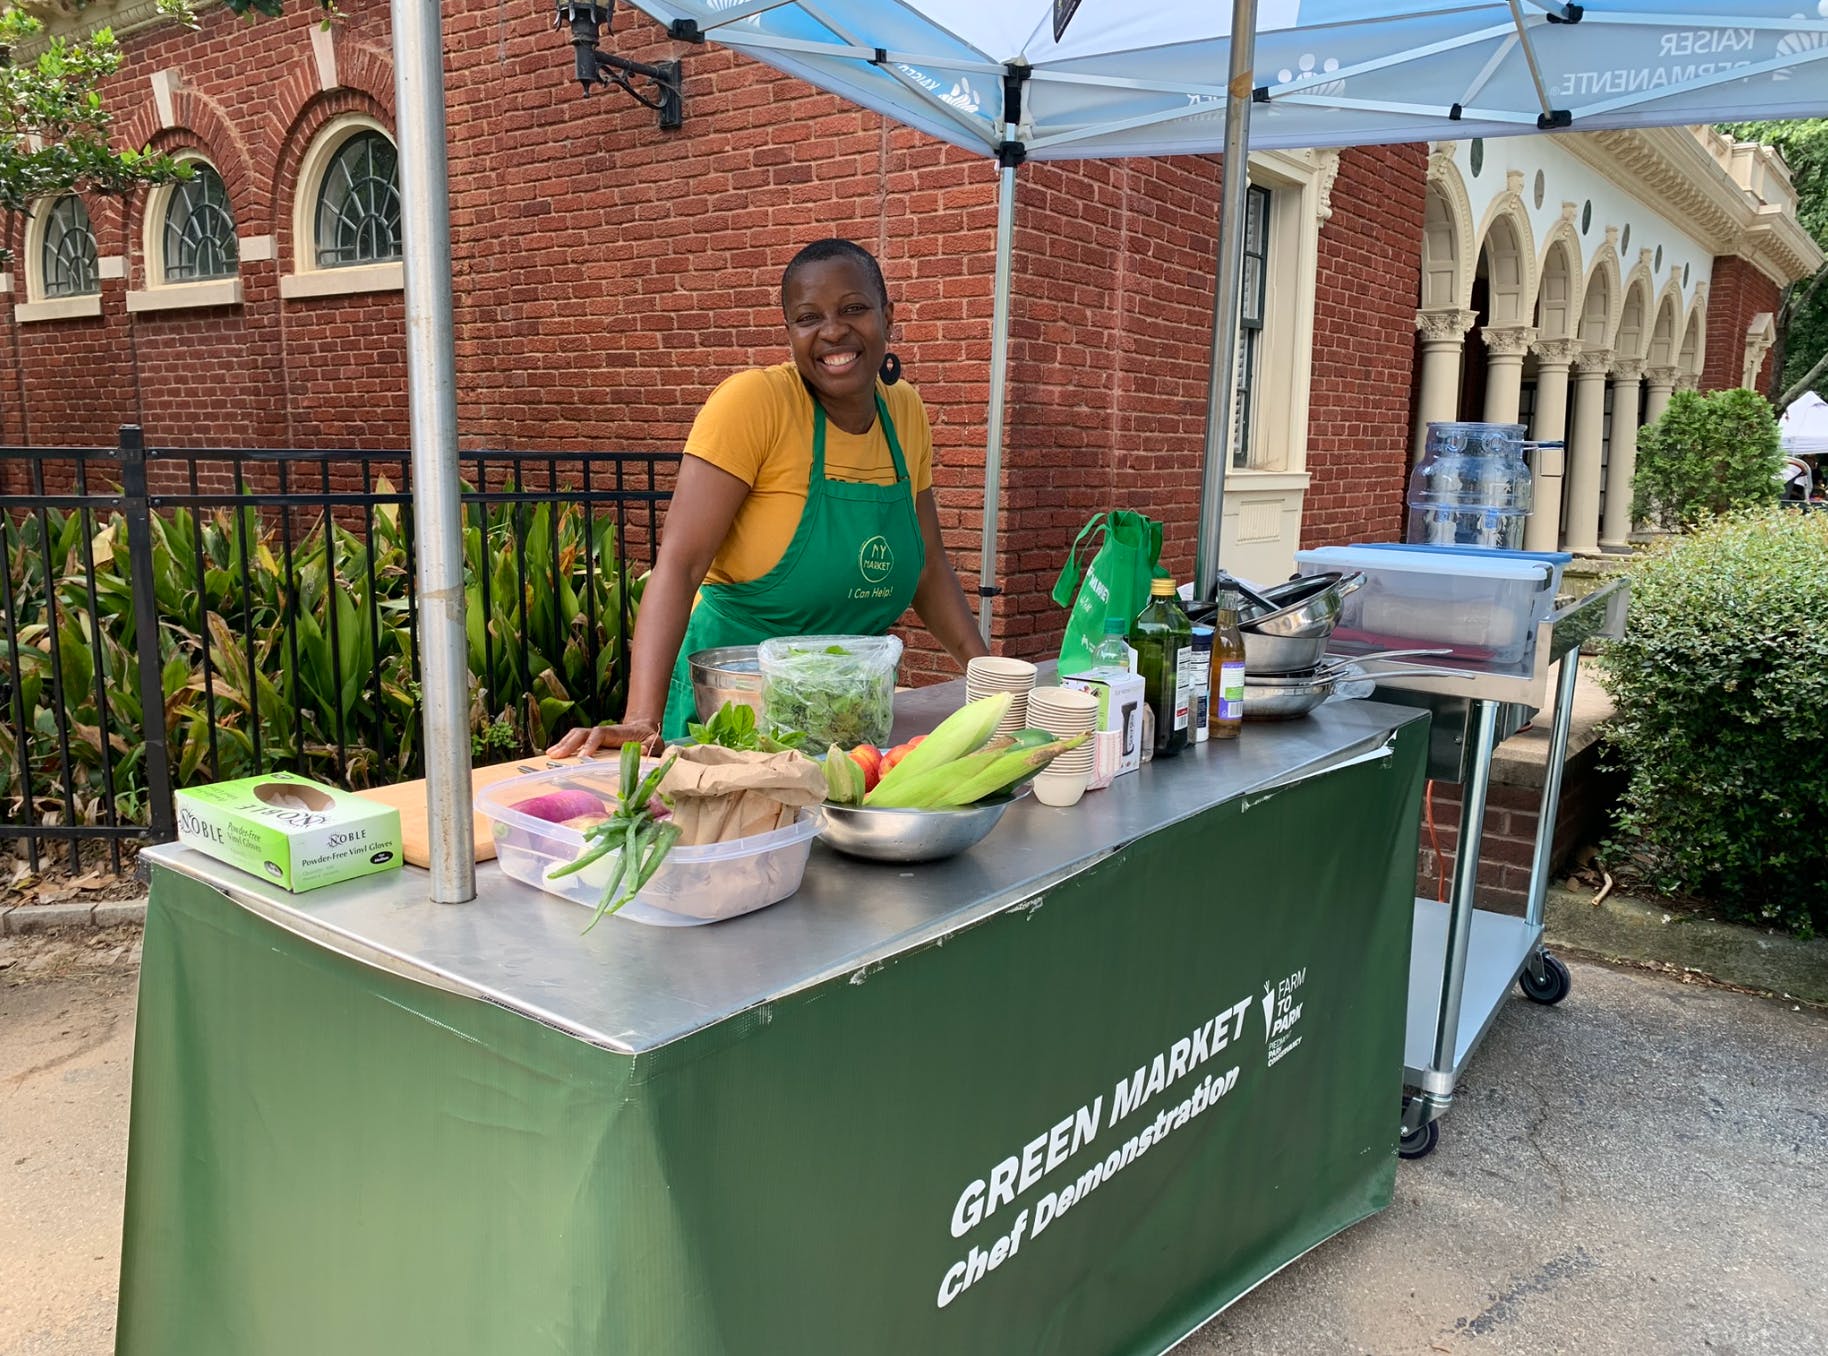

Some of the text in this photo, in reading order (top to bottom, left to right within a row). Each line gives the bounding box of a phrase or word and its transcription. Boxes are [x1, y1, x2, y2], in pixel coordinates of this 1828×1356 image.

[872, 543, 887, 560] MY
[863, 560, 891, 571] MARKET
[848, 586, 894, 599] I Can Help!
[179, 808, 225, 844] NOBLE
[228, 821, 262, 843] Powder-Free
[328, 829, 367, 848] NOBLE
[302, 840, 393, 867] Powder-Free Vinyl Gloves
[1278, 967, 1307, 1000] FARM
[1277, 994, 1292, 1017] TO
[1271, 1002, 1304, 1038] PARK
[950, 995, 1253, 1239] GREEN MARKET
[937, 1065, 1240, 1309] Chef Demonstration
